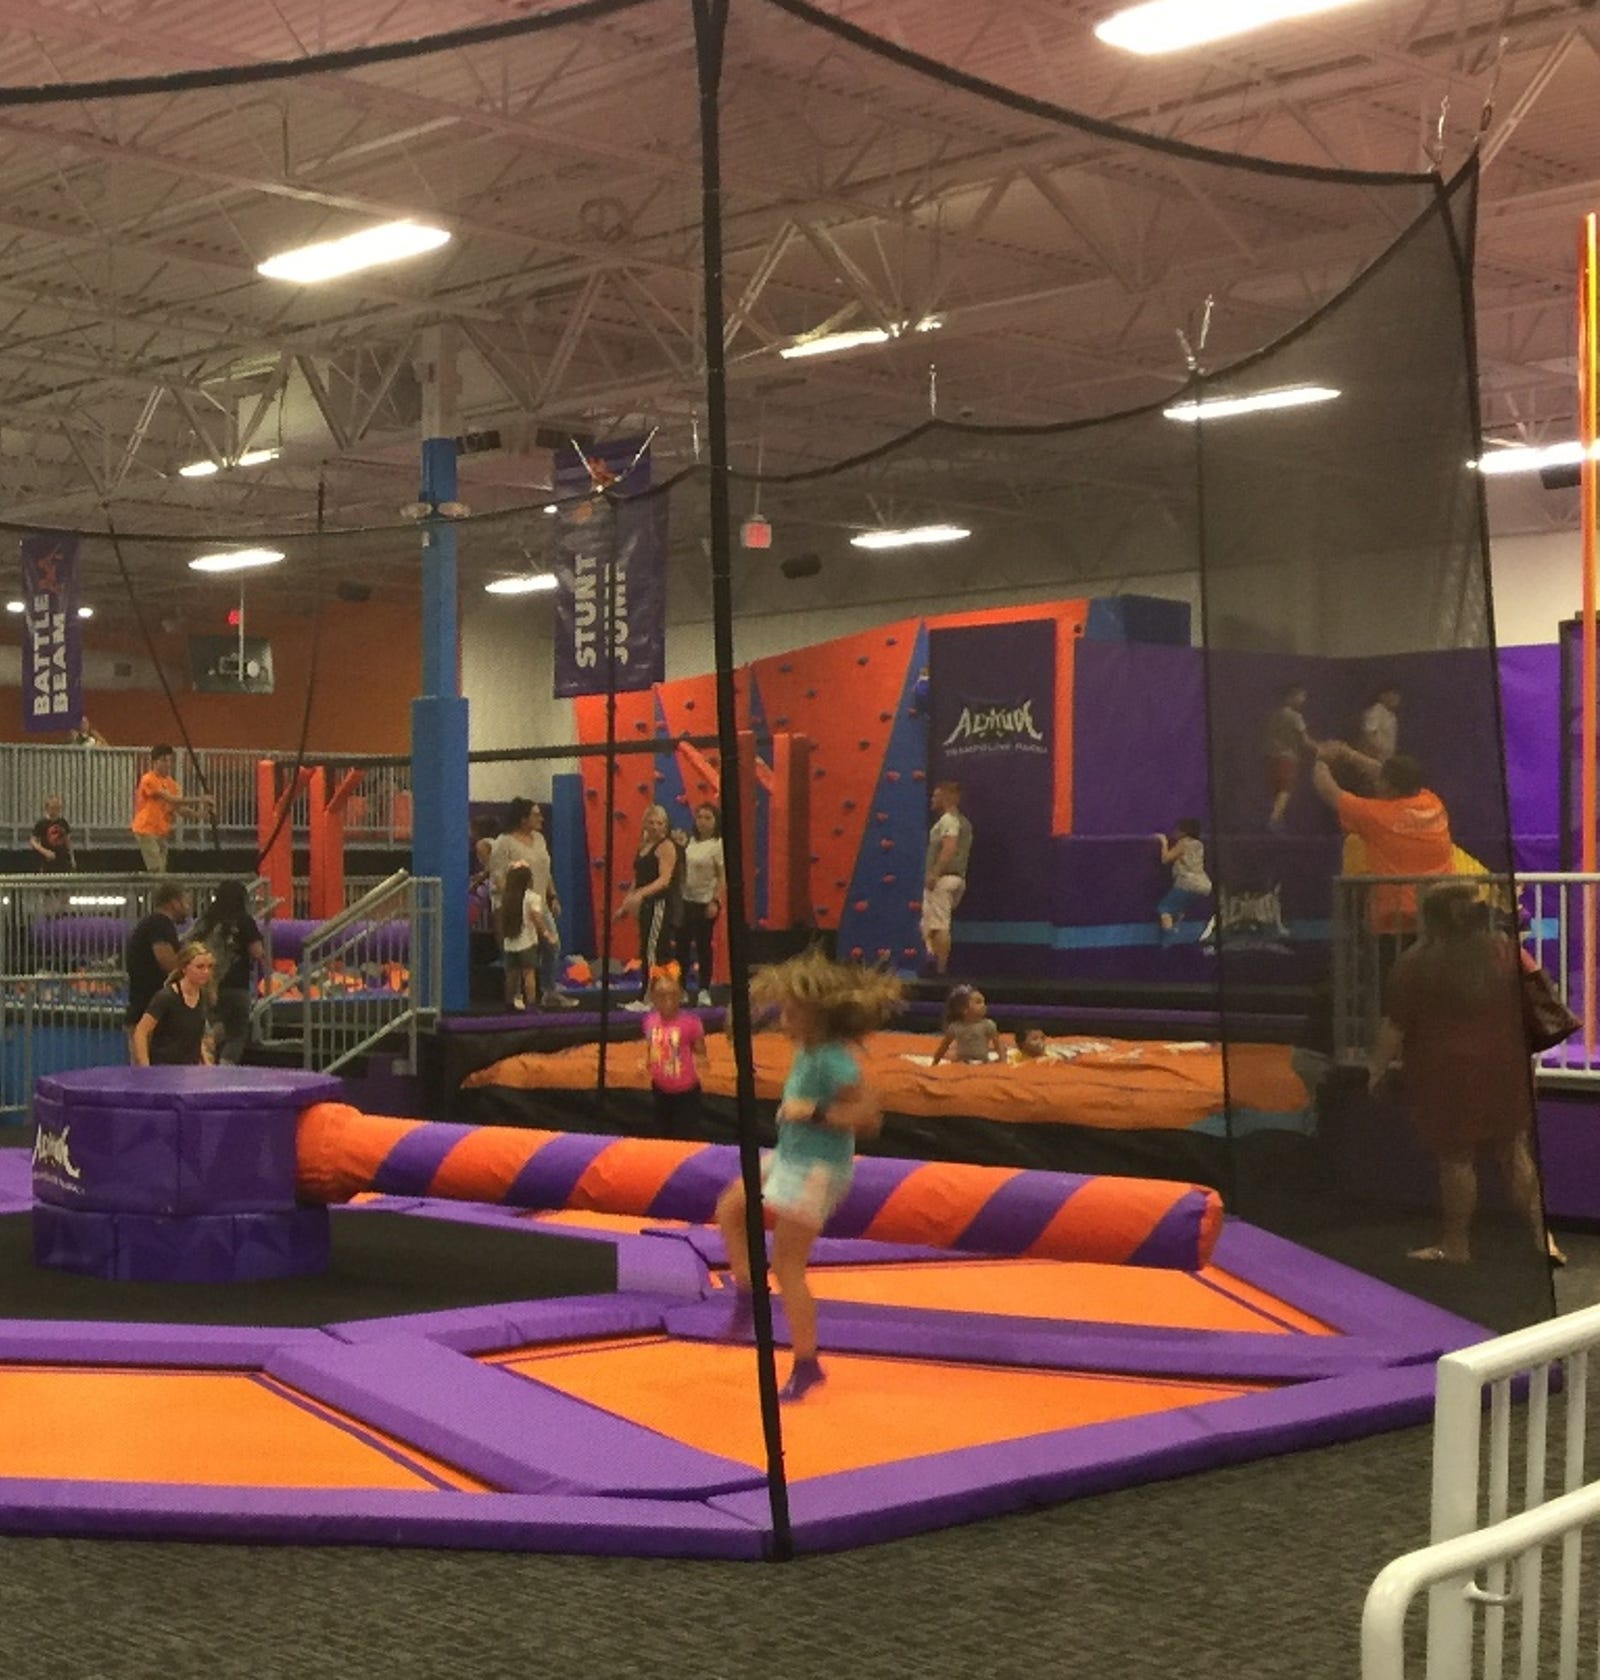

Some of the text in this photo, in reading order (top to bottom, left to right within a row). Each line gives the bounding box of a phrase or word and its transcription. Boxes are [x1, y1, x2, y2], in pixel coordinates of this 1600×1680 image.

[33, 594, 50, 716] BATTLE
[52, 613, 69, 713] BEAM
[574, 553, 597, 668] STUNT
[604, 562, 629, 665] JUMP
